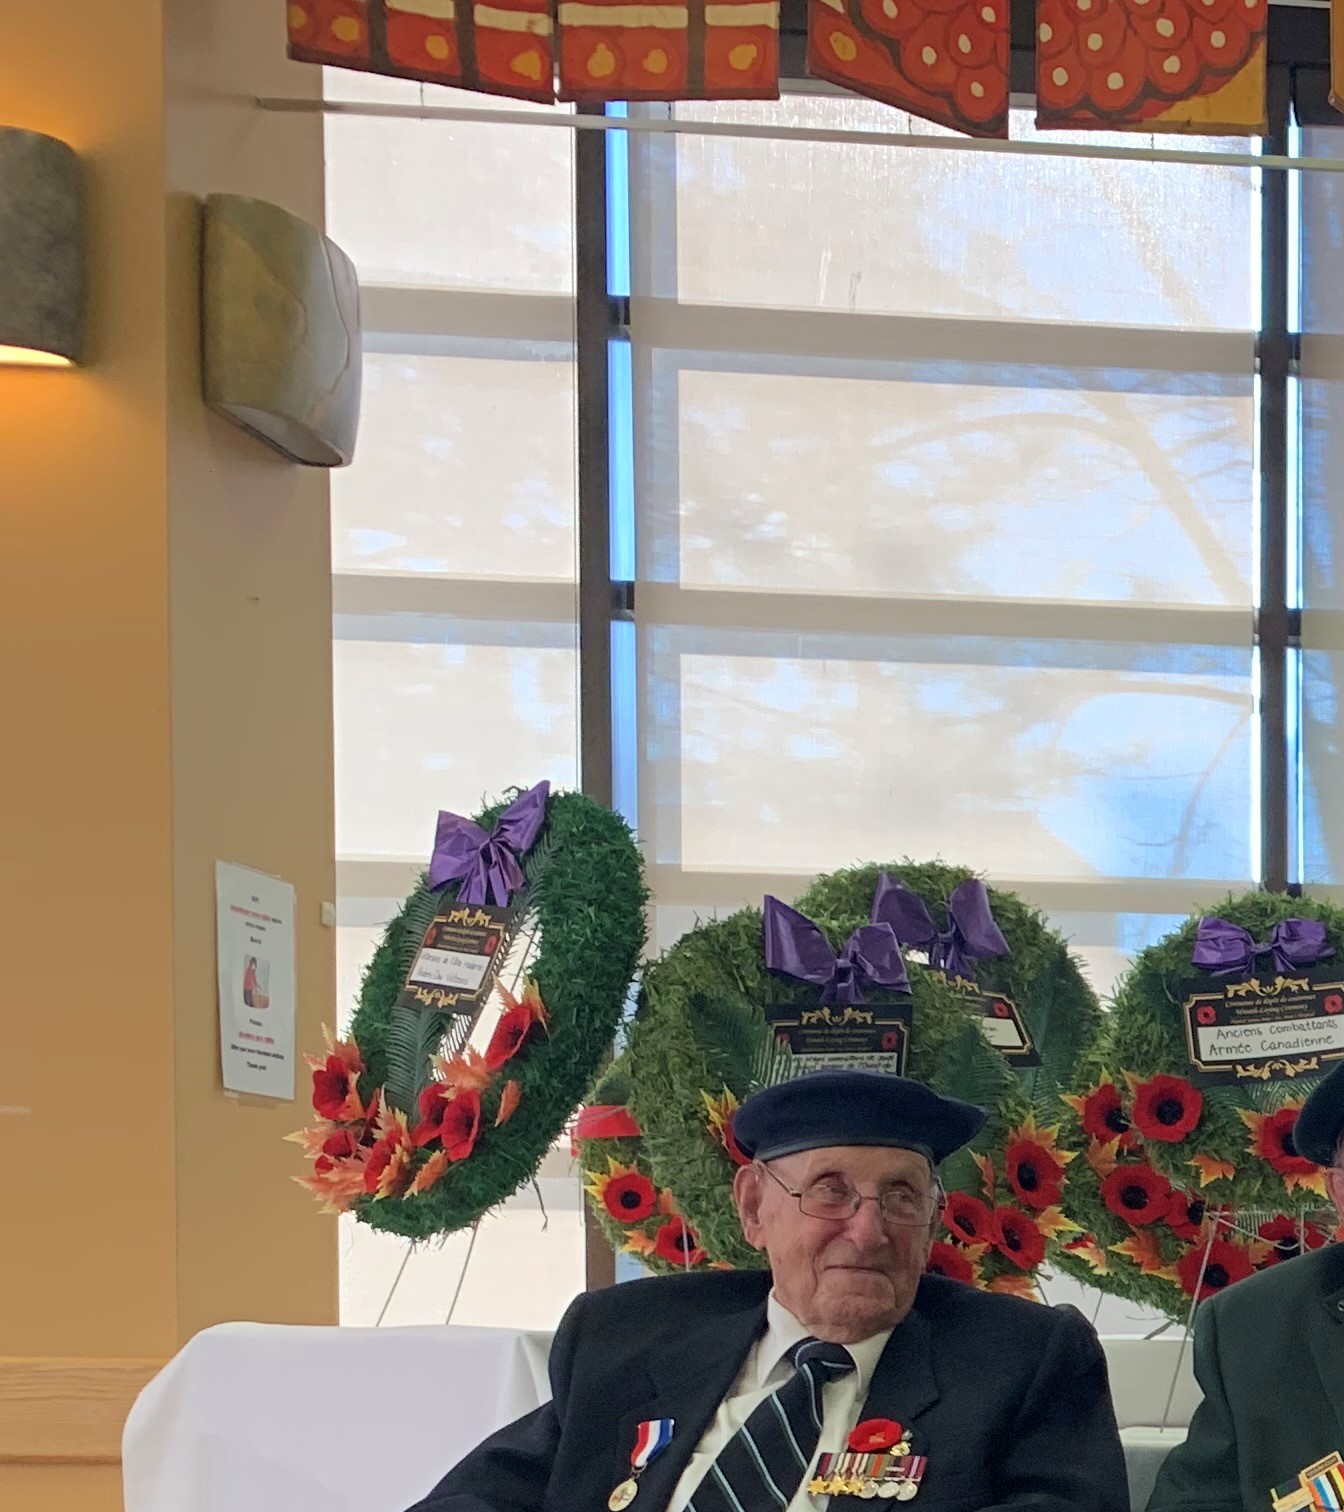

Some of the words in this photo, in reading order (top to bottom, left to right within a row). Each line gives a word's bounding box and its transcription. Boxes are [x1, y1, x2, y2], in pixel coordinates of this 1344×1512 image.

[1216, 1028, 1263, 1041] Anciens
[1209, 1042, 1252, 1057] Armée
[1260, 1035, 1334, 1052] Canadienne
